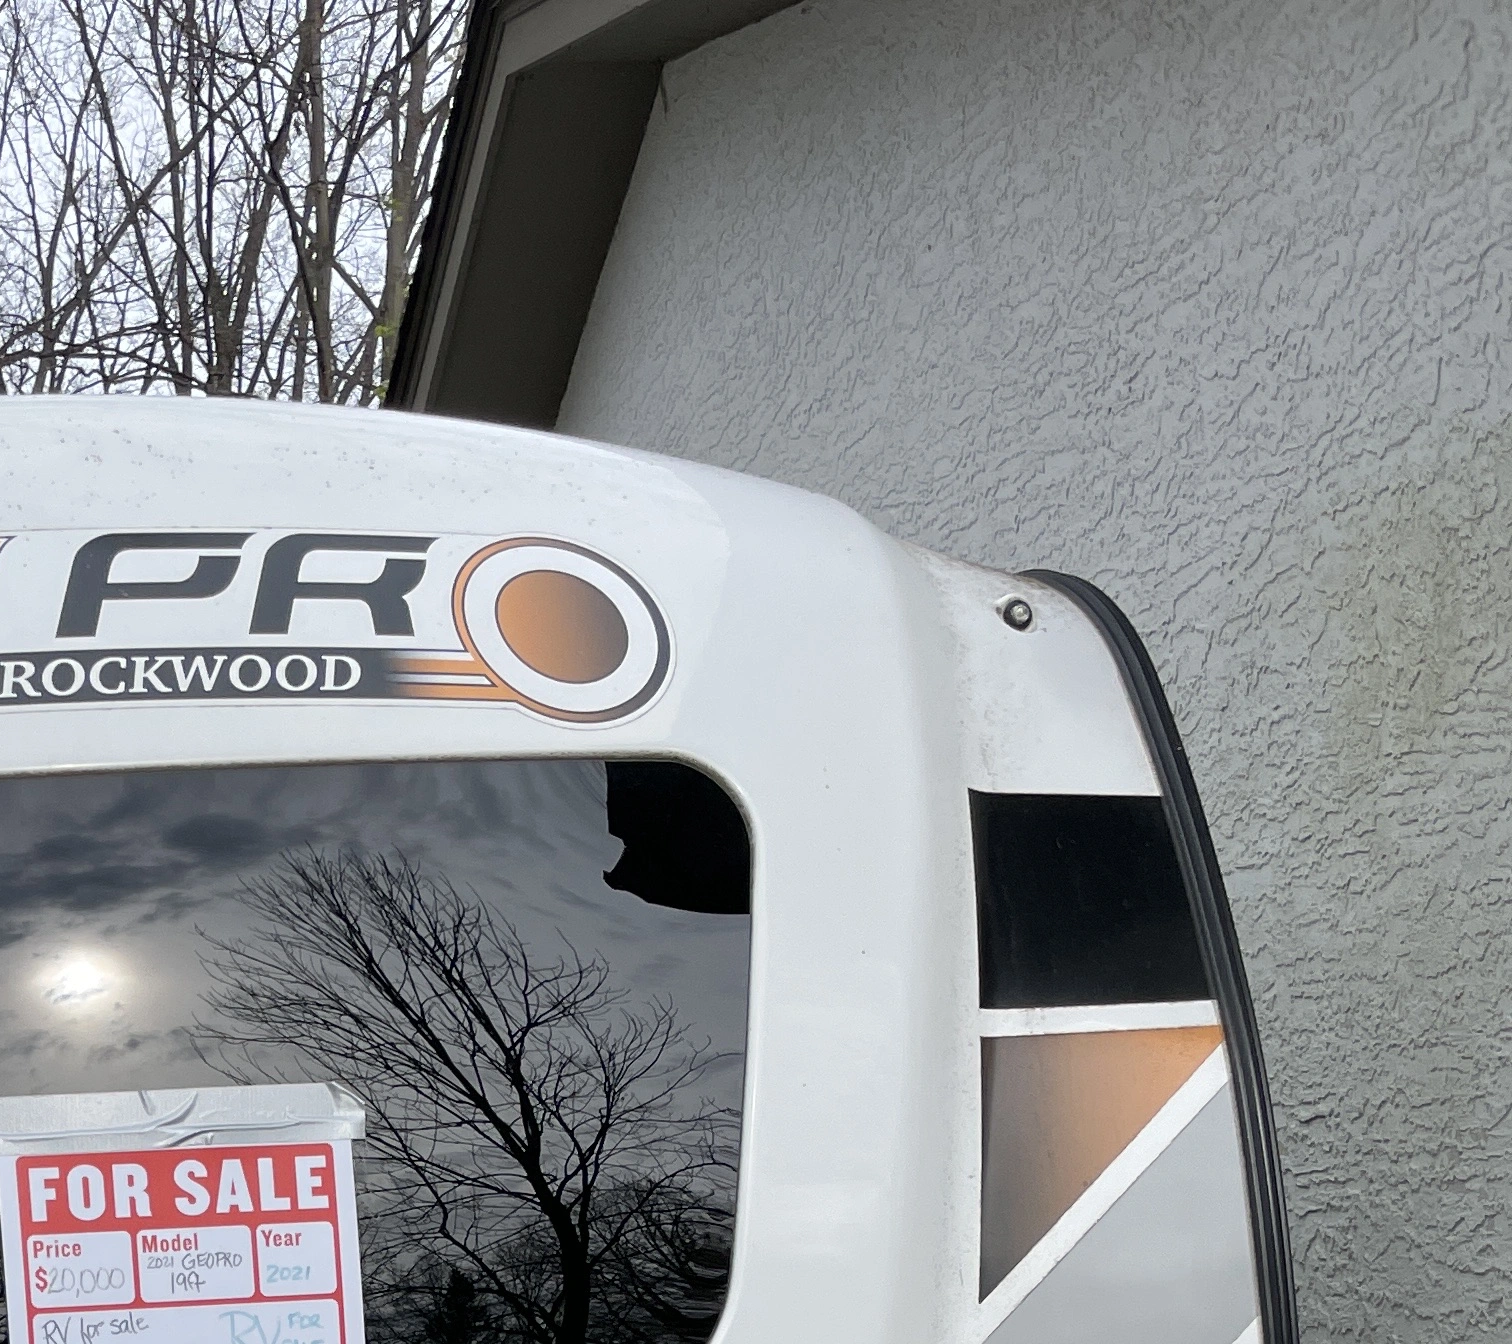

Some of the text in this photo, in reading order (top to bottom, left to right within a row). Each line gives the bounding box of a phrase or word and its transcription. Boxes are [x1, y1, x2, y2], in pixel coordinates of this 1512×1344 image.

[28, 1155, 330, 1222] FOR SALE
[141, 1233, 199, 1253] Model
[261, 1229, 302, 1247] Year
[32, 1239, 82, 1258] Price
[146, 1251, 243, 1271] 2021 GEOPRO
[266, 1264, 311, 1283] 2021
[110, 1311, 149, 1335] sale
[288, 1311, 324, 1329] FOR
